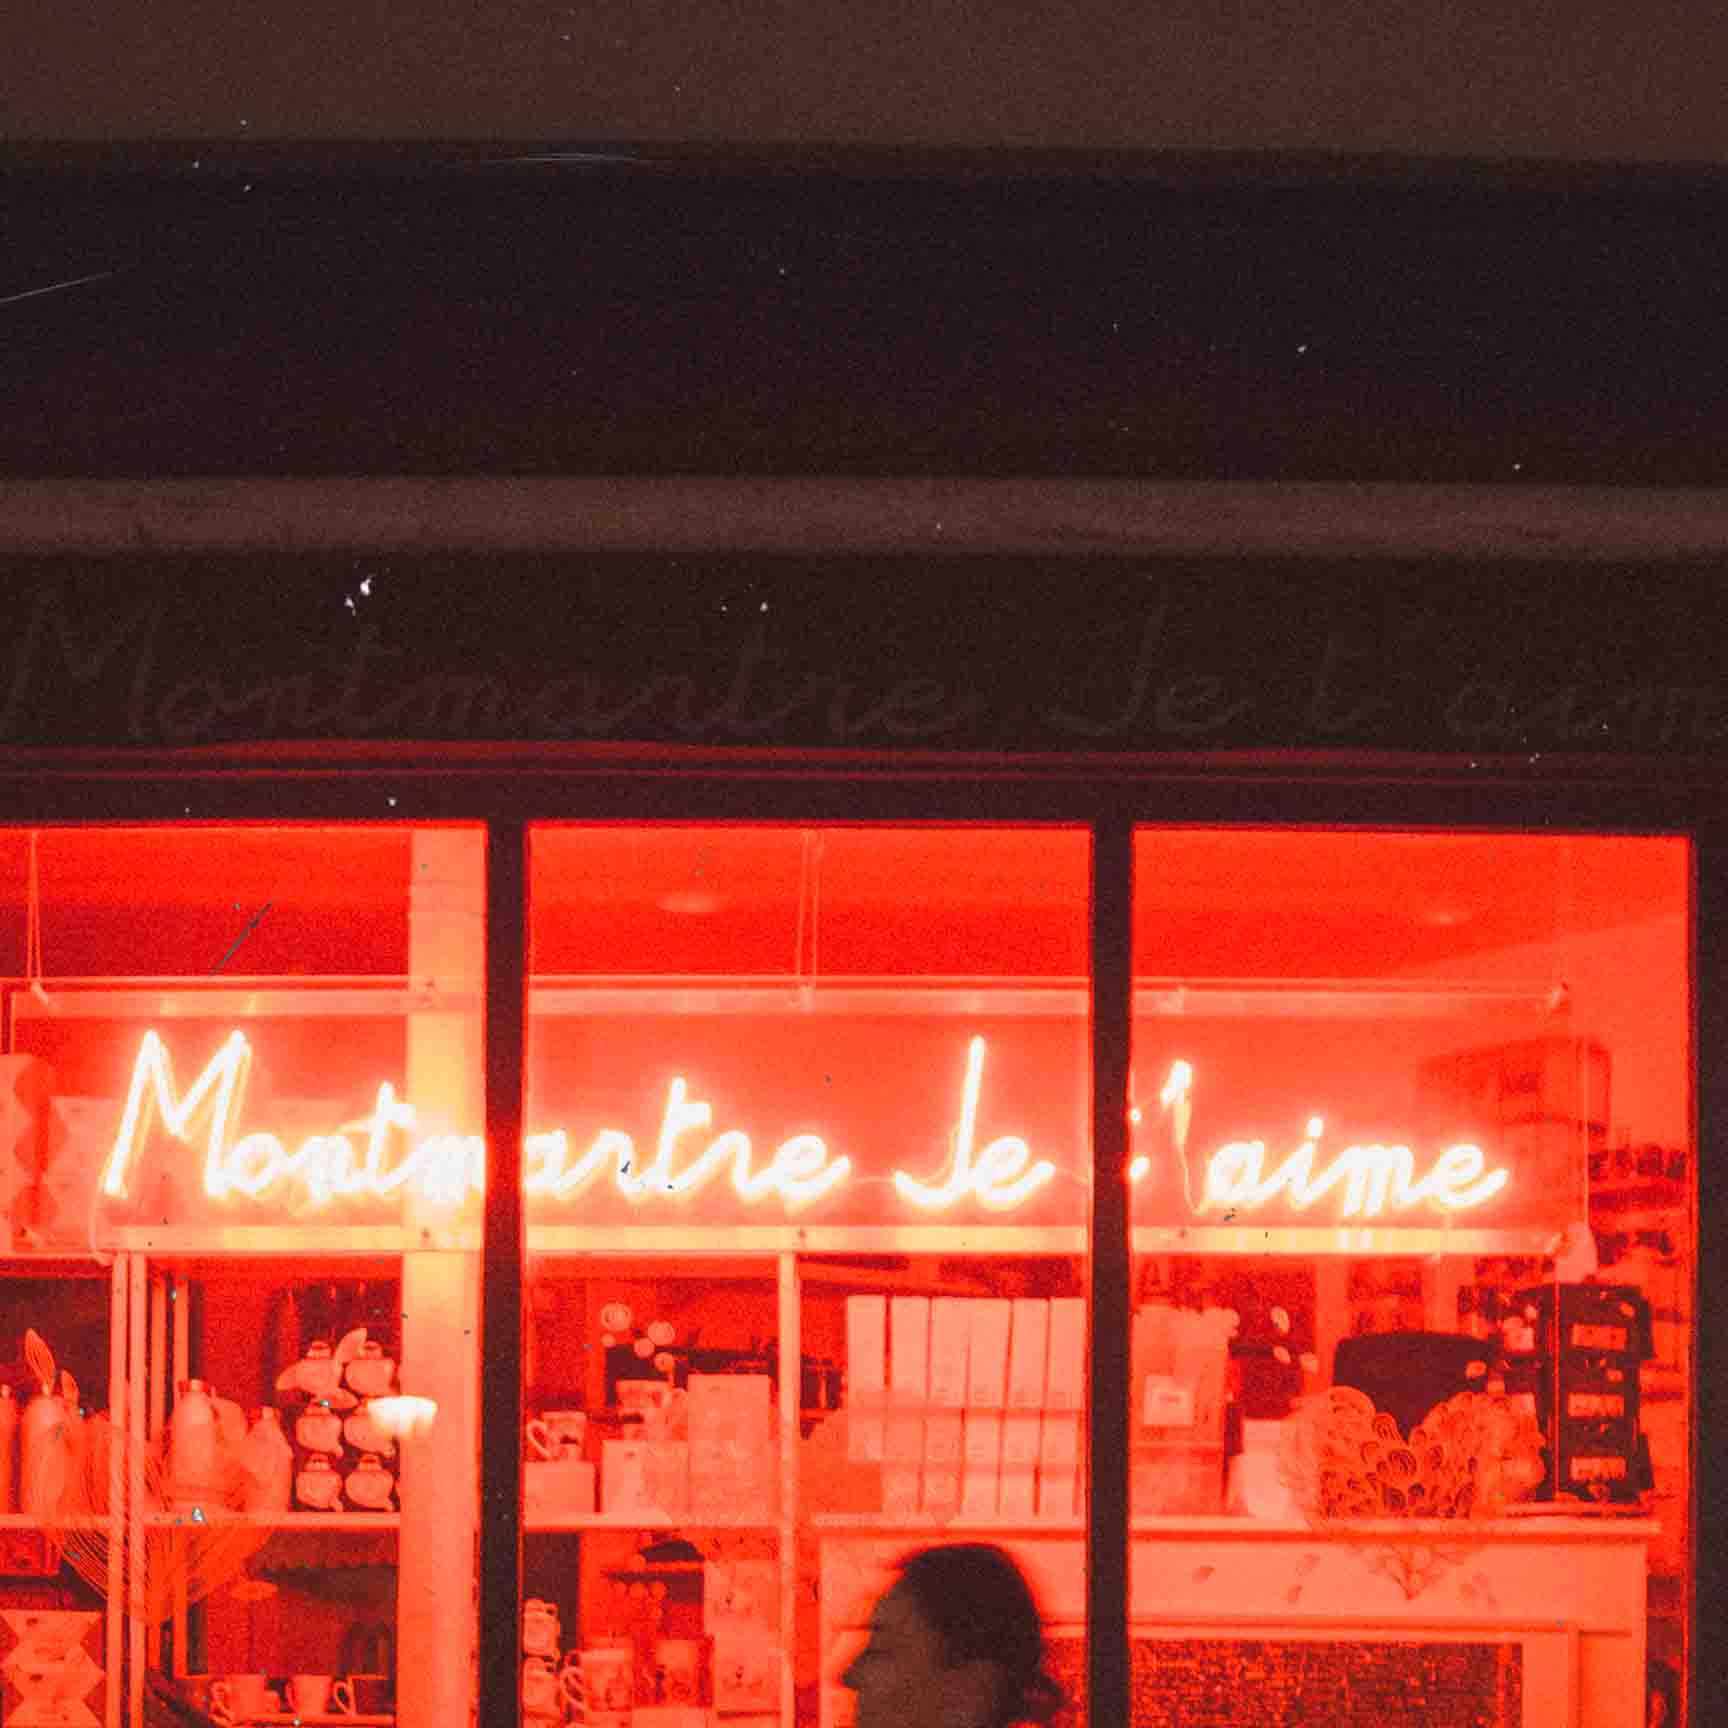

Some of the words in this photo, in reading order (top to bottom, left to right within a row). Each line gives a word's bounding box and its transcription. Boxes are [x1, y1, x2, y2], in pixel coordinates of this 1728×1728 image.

[1050, 584, 1252, 734] Je
[892, 1036, 1053, 1208] Je
[1129, 1058, 1510, 1216] 'aime
